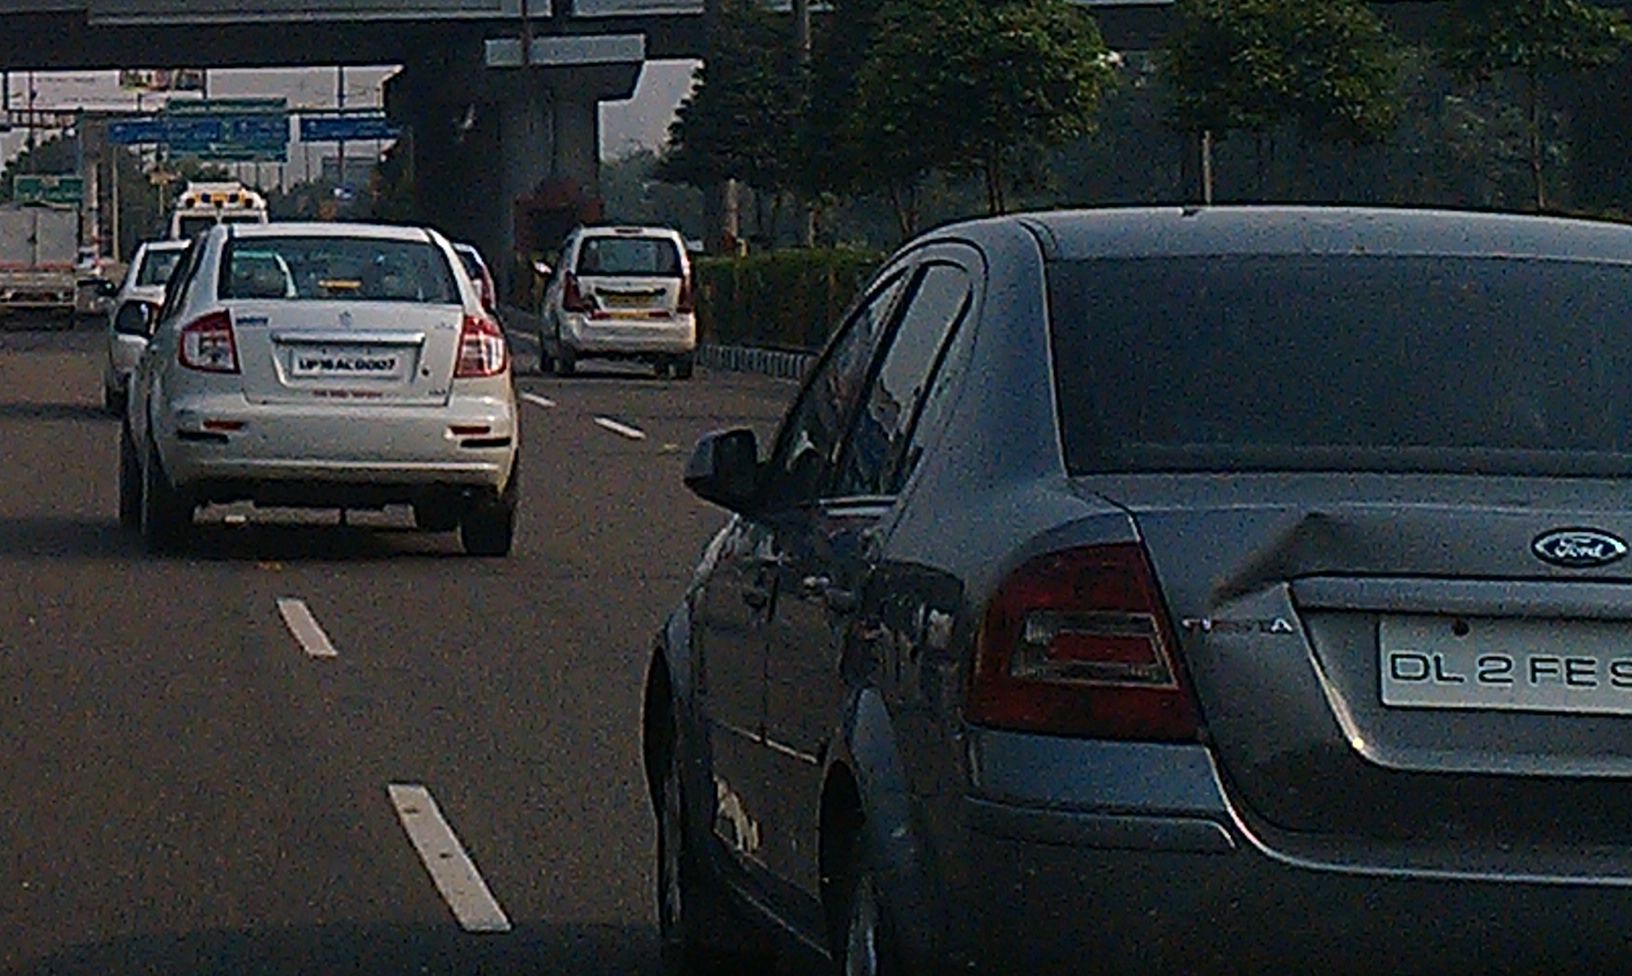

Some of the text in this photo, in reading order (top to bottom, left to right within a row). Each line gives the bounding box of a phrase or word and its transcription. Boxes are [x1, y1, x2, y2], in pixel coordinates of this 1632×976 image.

[1554, 534, 1605, 559] Ford
[1390, 653, 1465, 684] DL
[1478, 656, 1513, 683] 2
